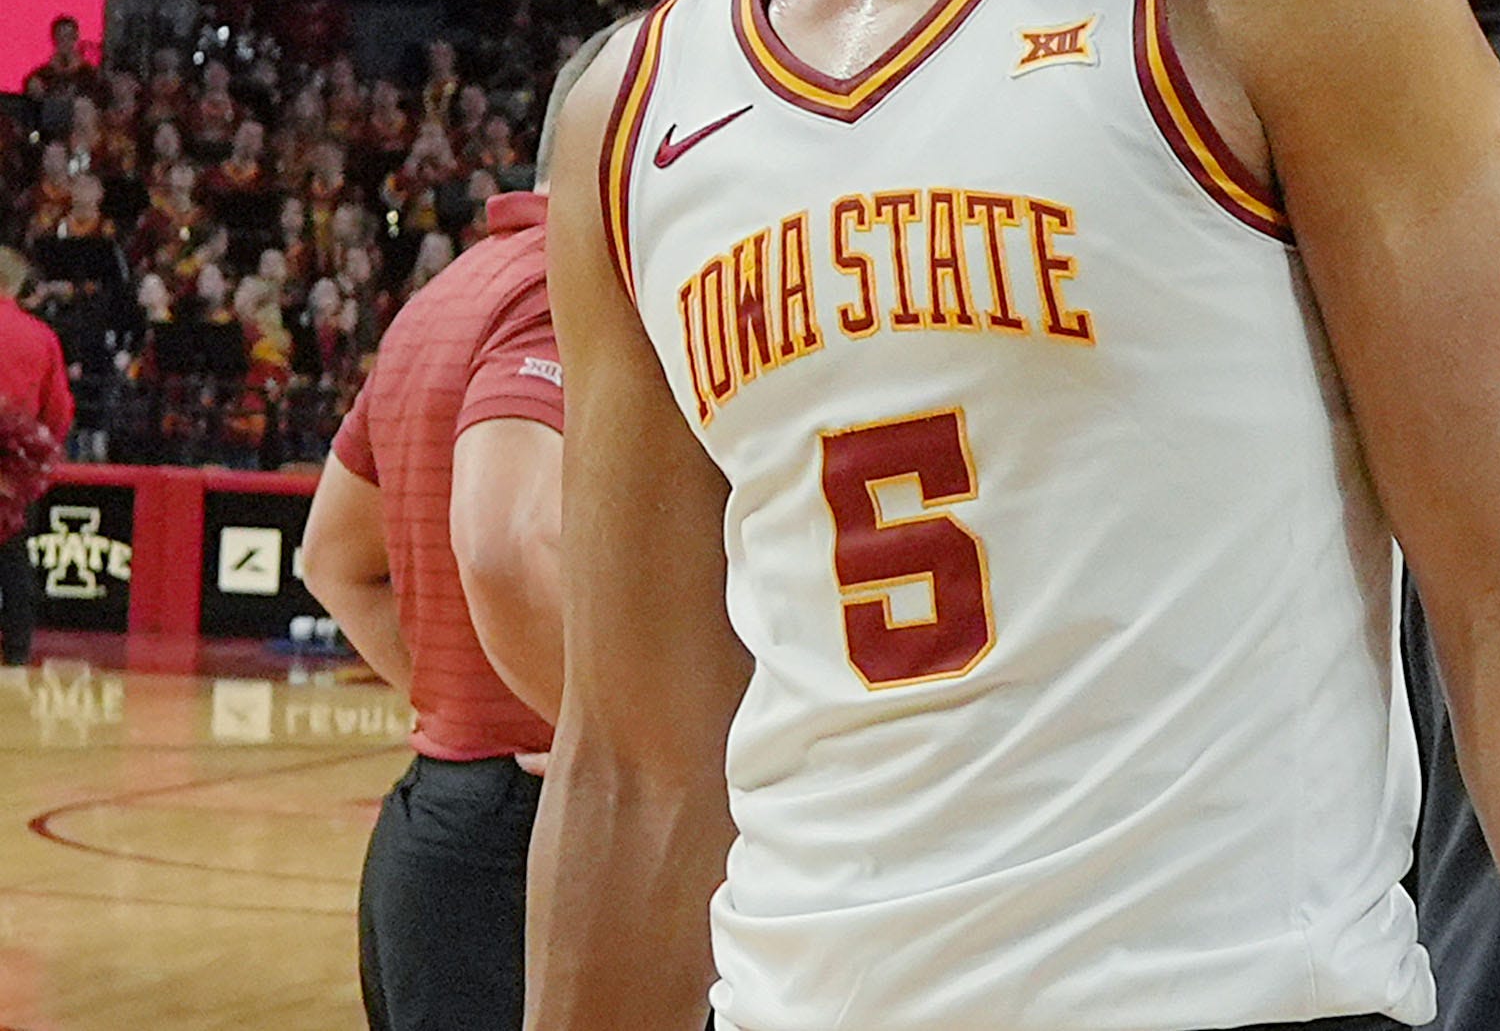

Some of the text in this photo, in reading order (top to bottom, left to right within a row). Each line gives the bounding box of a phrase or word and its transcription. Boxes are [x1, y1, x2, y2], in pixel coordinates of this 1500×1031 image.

[678, 186, 1097, 429] IOWA STATE
[818, 404, 998, 692] 5
